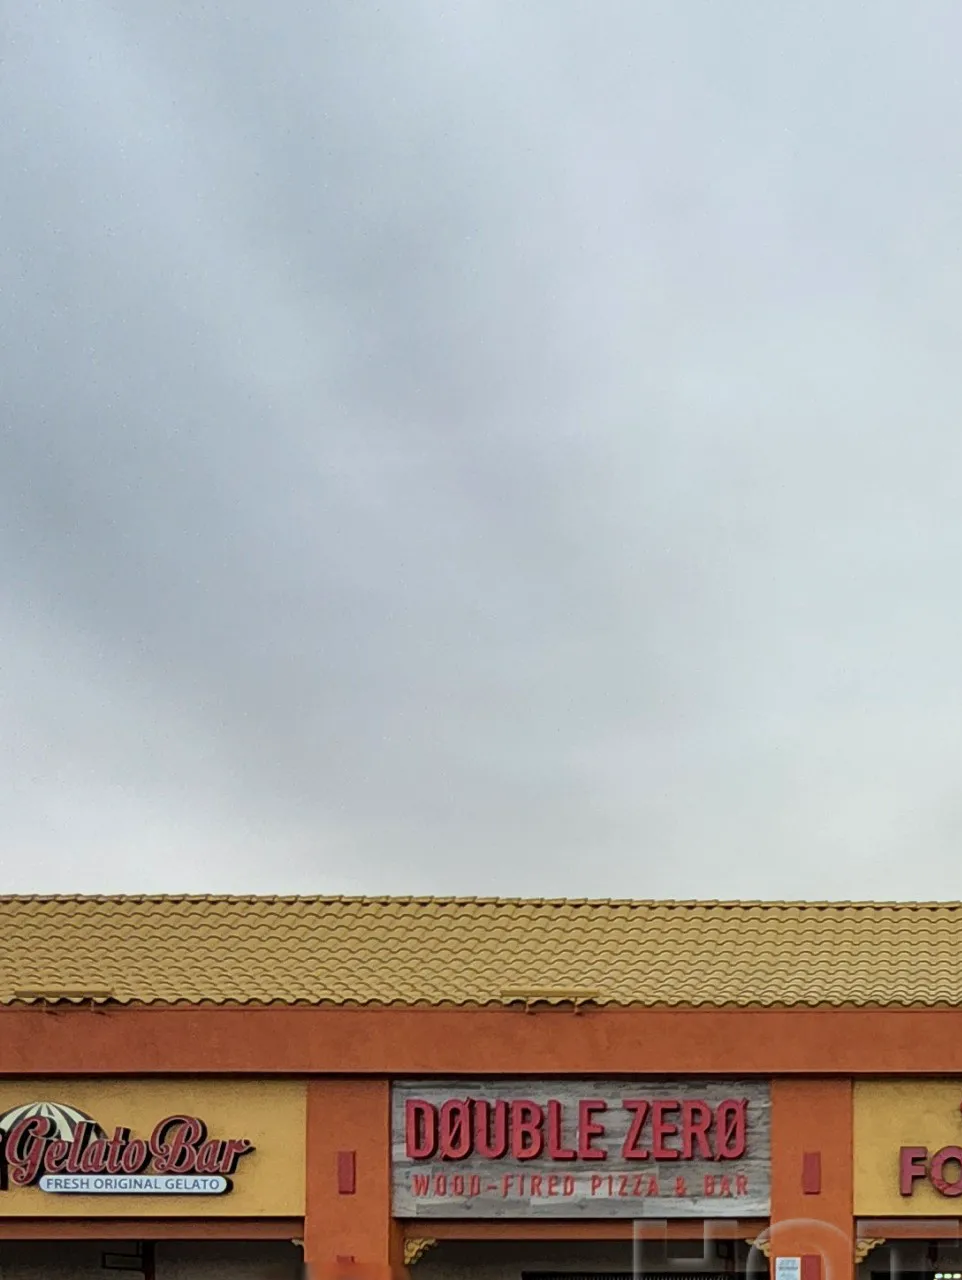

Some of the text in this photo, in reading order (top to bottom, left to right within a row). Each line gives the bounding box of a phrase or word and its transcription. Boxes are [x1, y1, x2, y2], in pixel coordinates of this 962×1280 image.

[6, 1116, 148, 1186] Gelato
[150, 1115, 254, 1174] Bar
[46, 1178, 220, 1190] FRESH ORIGINAL GELATO
[411, 1174, 750, 1197] WOOD-FIRED PIZZA & BAR
